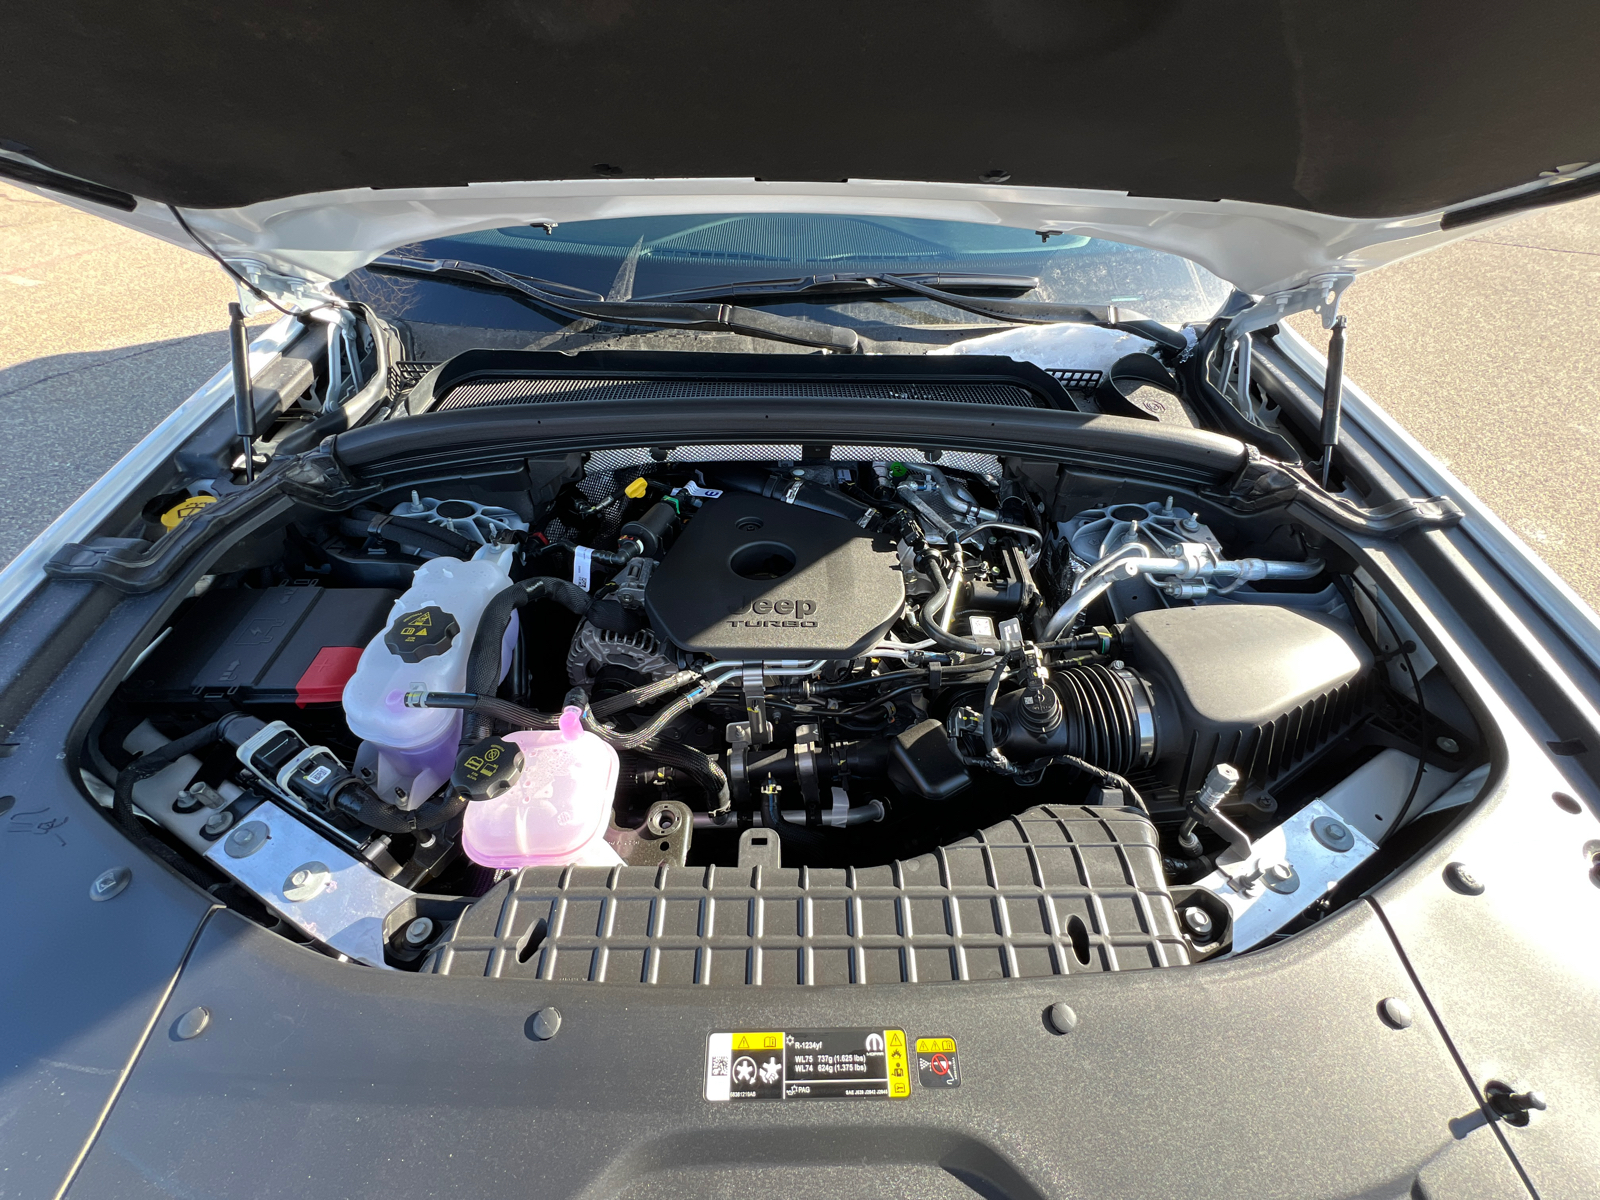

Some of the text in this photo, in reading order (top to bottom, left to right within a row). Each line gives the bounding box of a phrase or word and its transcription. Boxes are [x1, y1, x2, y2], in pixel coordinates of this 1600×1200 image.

[728, 596, 817, 619] Jeep
[726, 620, 819, 628] TURBO
[794, 1041, 823, 1051] R-1234yf
[794, 1054, 867, 1064] WL75 737g (1.625 lbs)
[794, 1063, 867, 1073] WL74 624g (1.375 lbs)
[798, 1086, 811, 1094] PAG
